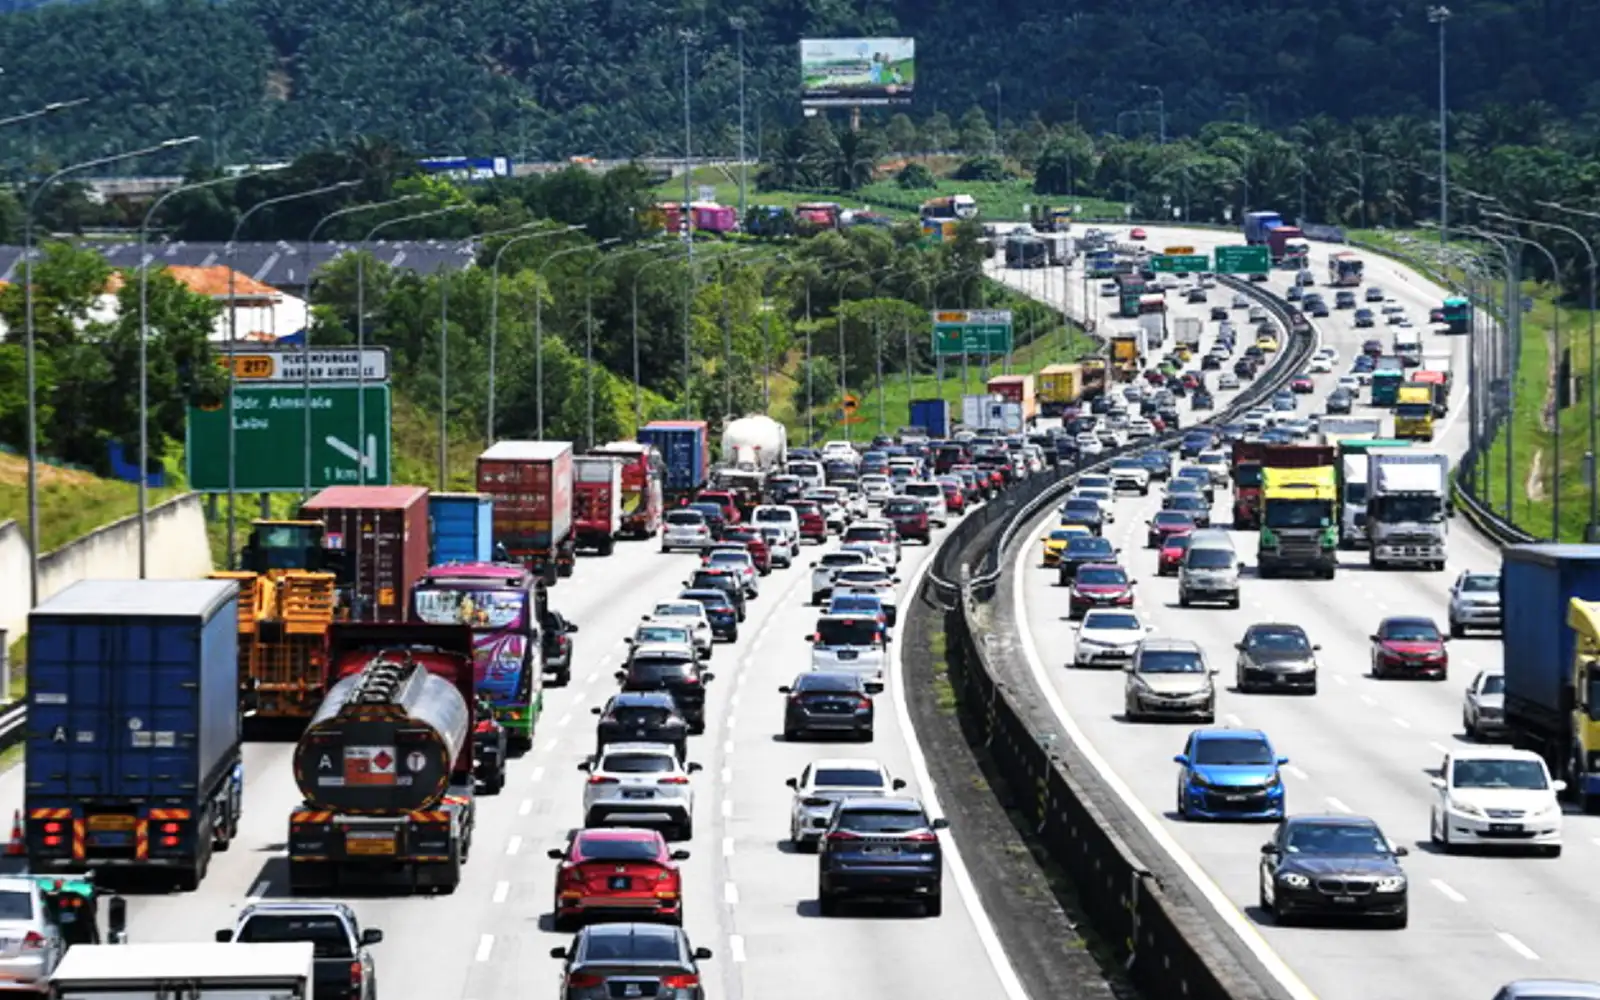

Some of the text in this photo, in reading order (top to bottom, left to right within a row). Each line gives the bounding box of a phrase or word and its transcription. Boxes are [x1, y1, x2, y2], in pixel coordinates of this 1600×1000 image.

[232, 416, 269, 430] Labu
[324, 466, 358, 480] 1 km
[53, 726, 66, 741] A
[319, 753, 332, 769] A
